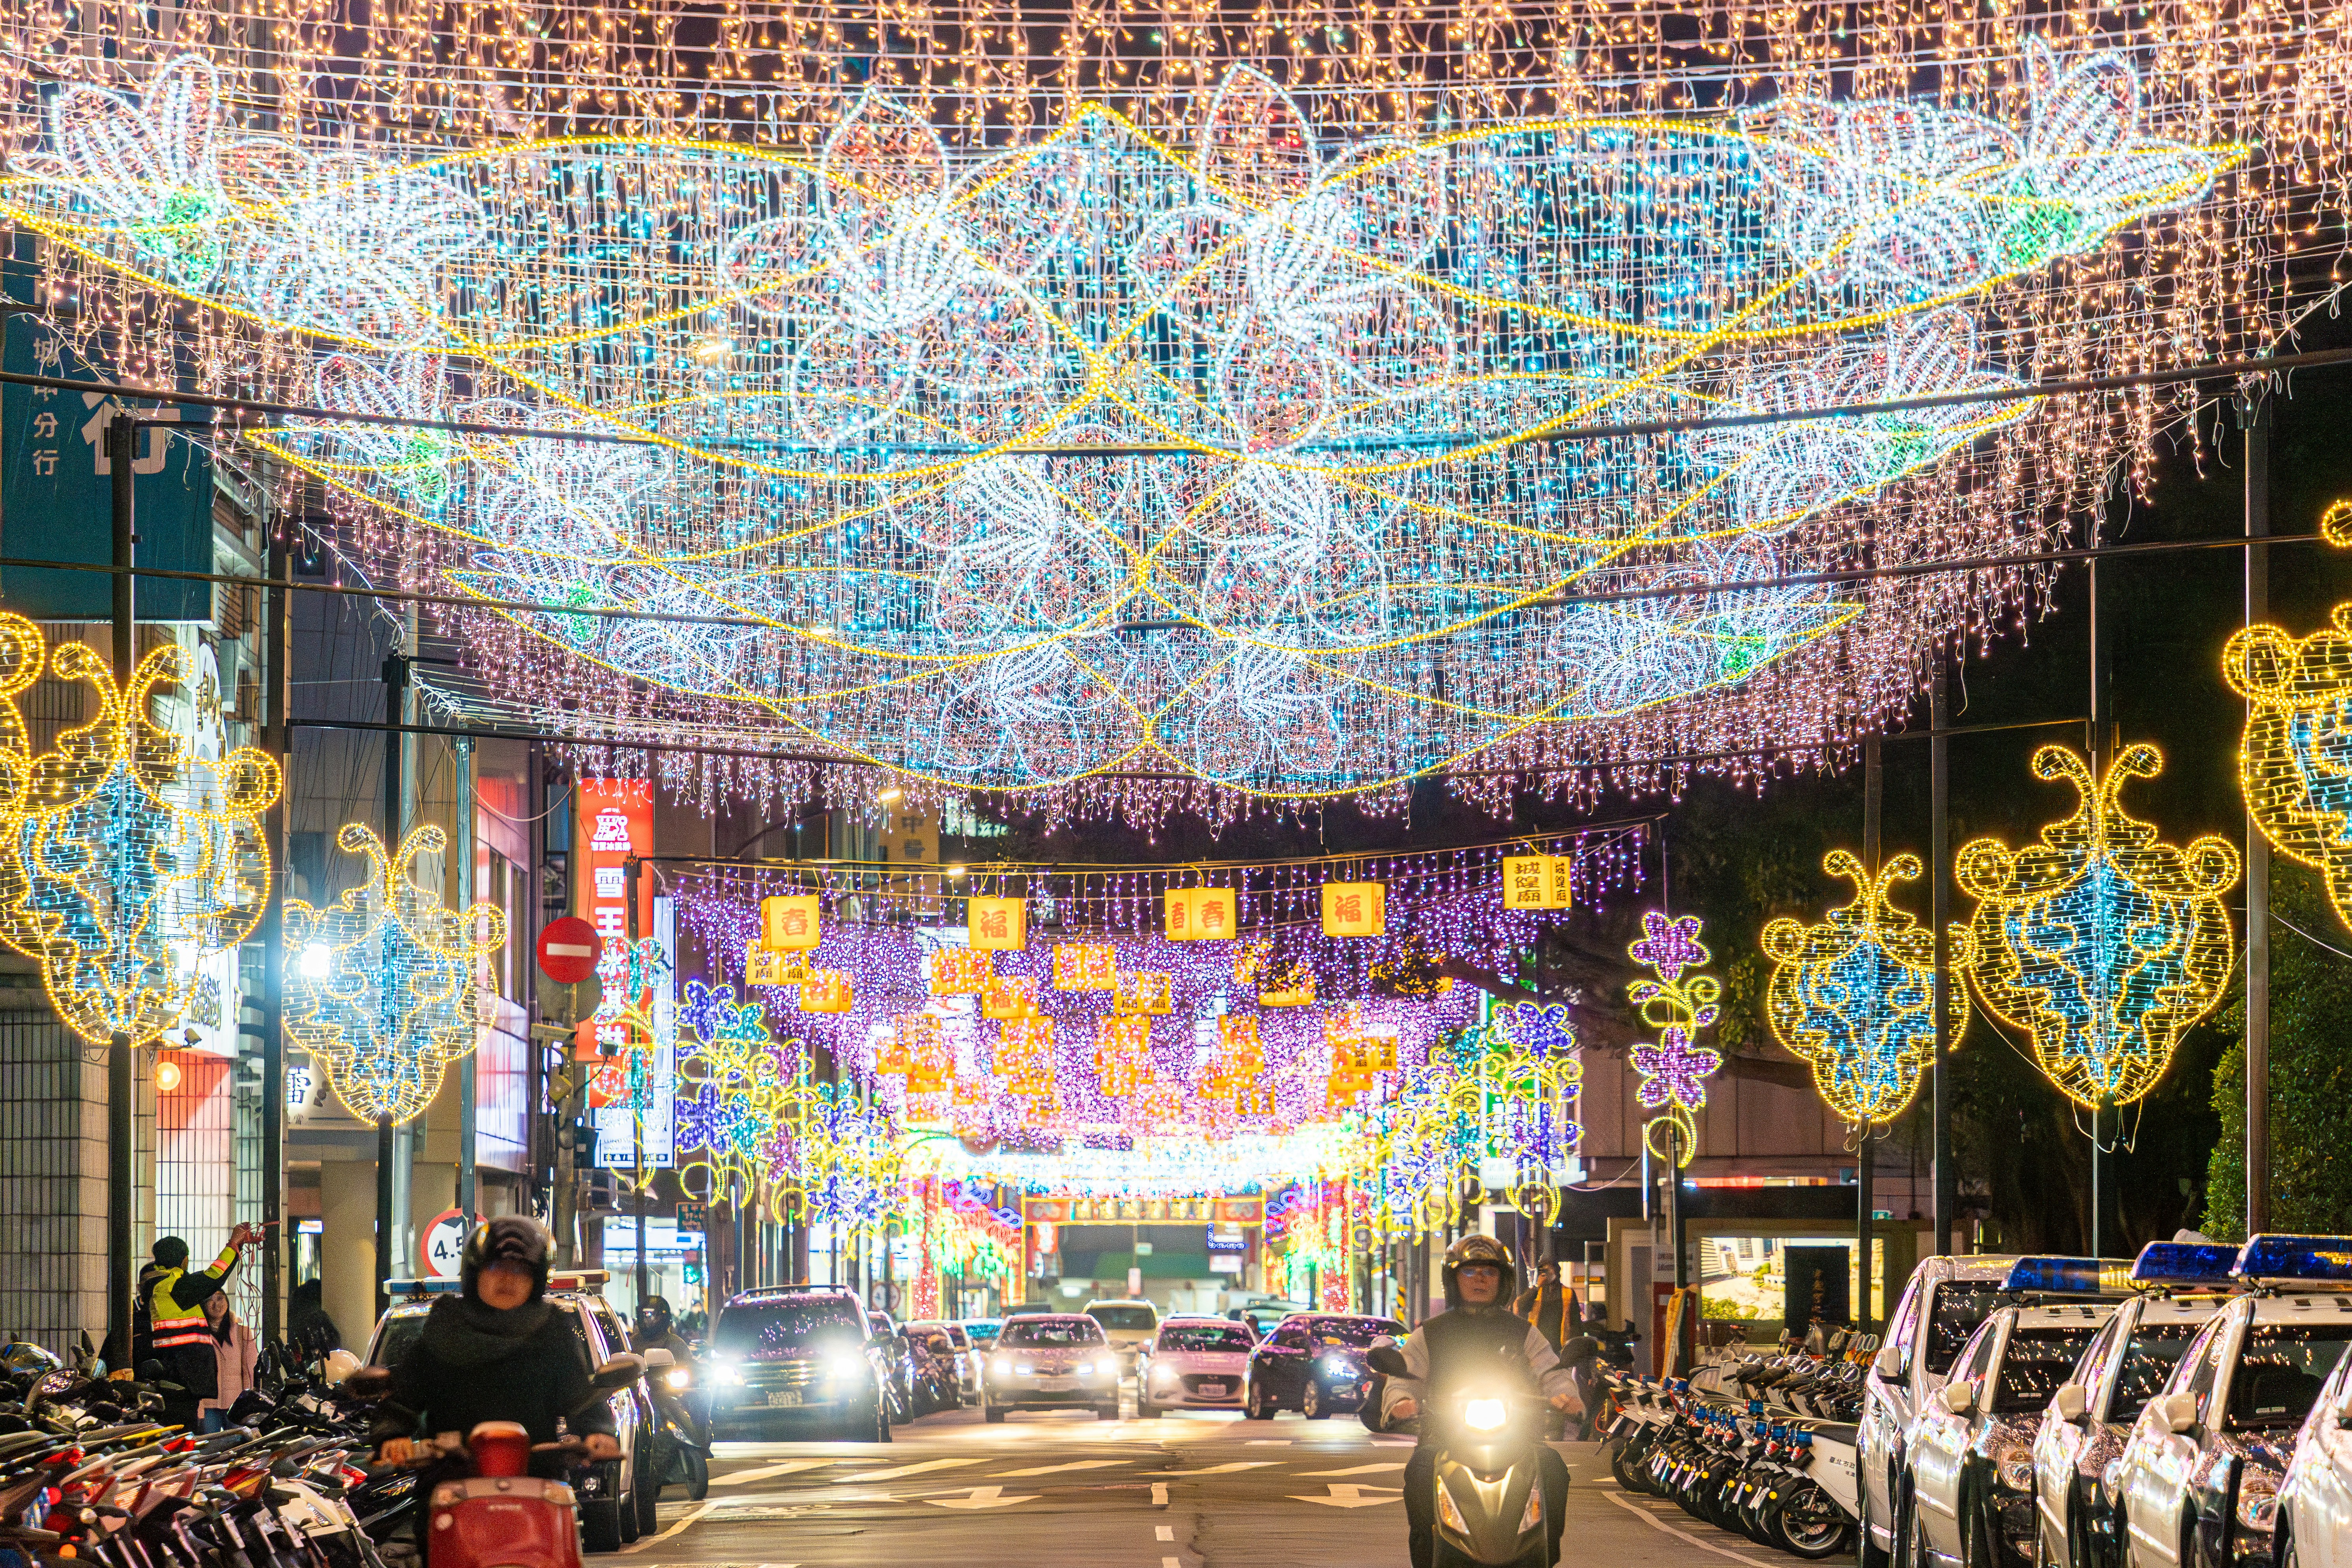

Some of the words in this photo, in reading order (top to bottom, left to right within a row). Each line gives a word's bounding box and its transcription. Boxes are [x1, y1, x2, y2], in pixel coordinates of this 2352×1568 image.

[1515, 862, 1540, 902] 城隍廟
[782, 908, 808, 936] 春
[1171, 902, 1184, 929] 春
[1201, 900, 1225, 928] 春
[1335, 894, 1361, 922] 福
[980, 910, 1007, 938] 福
